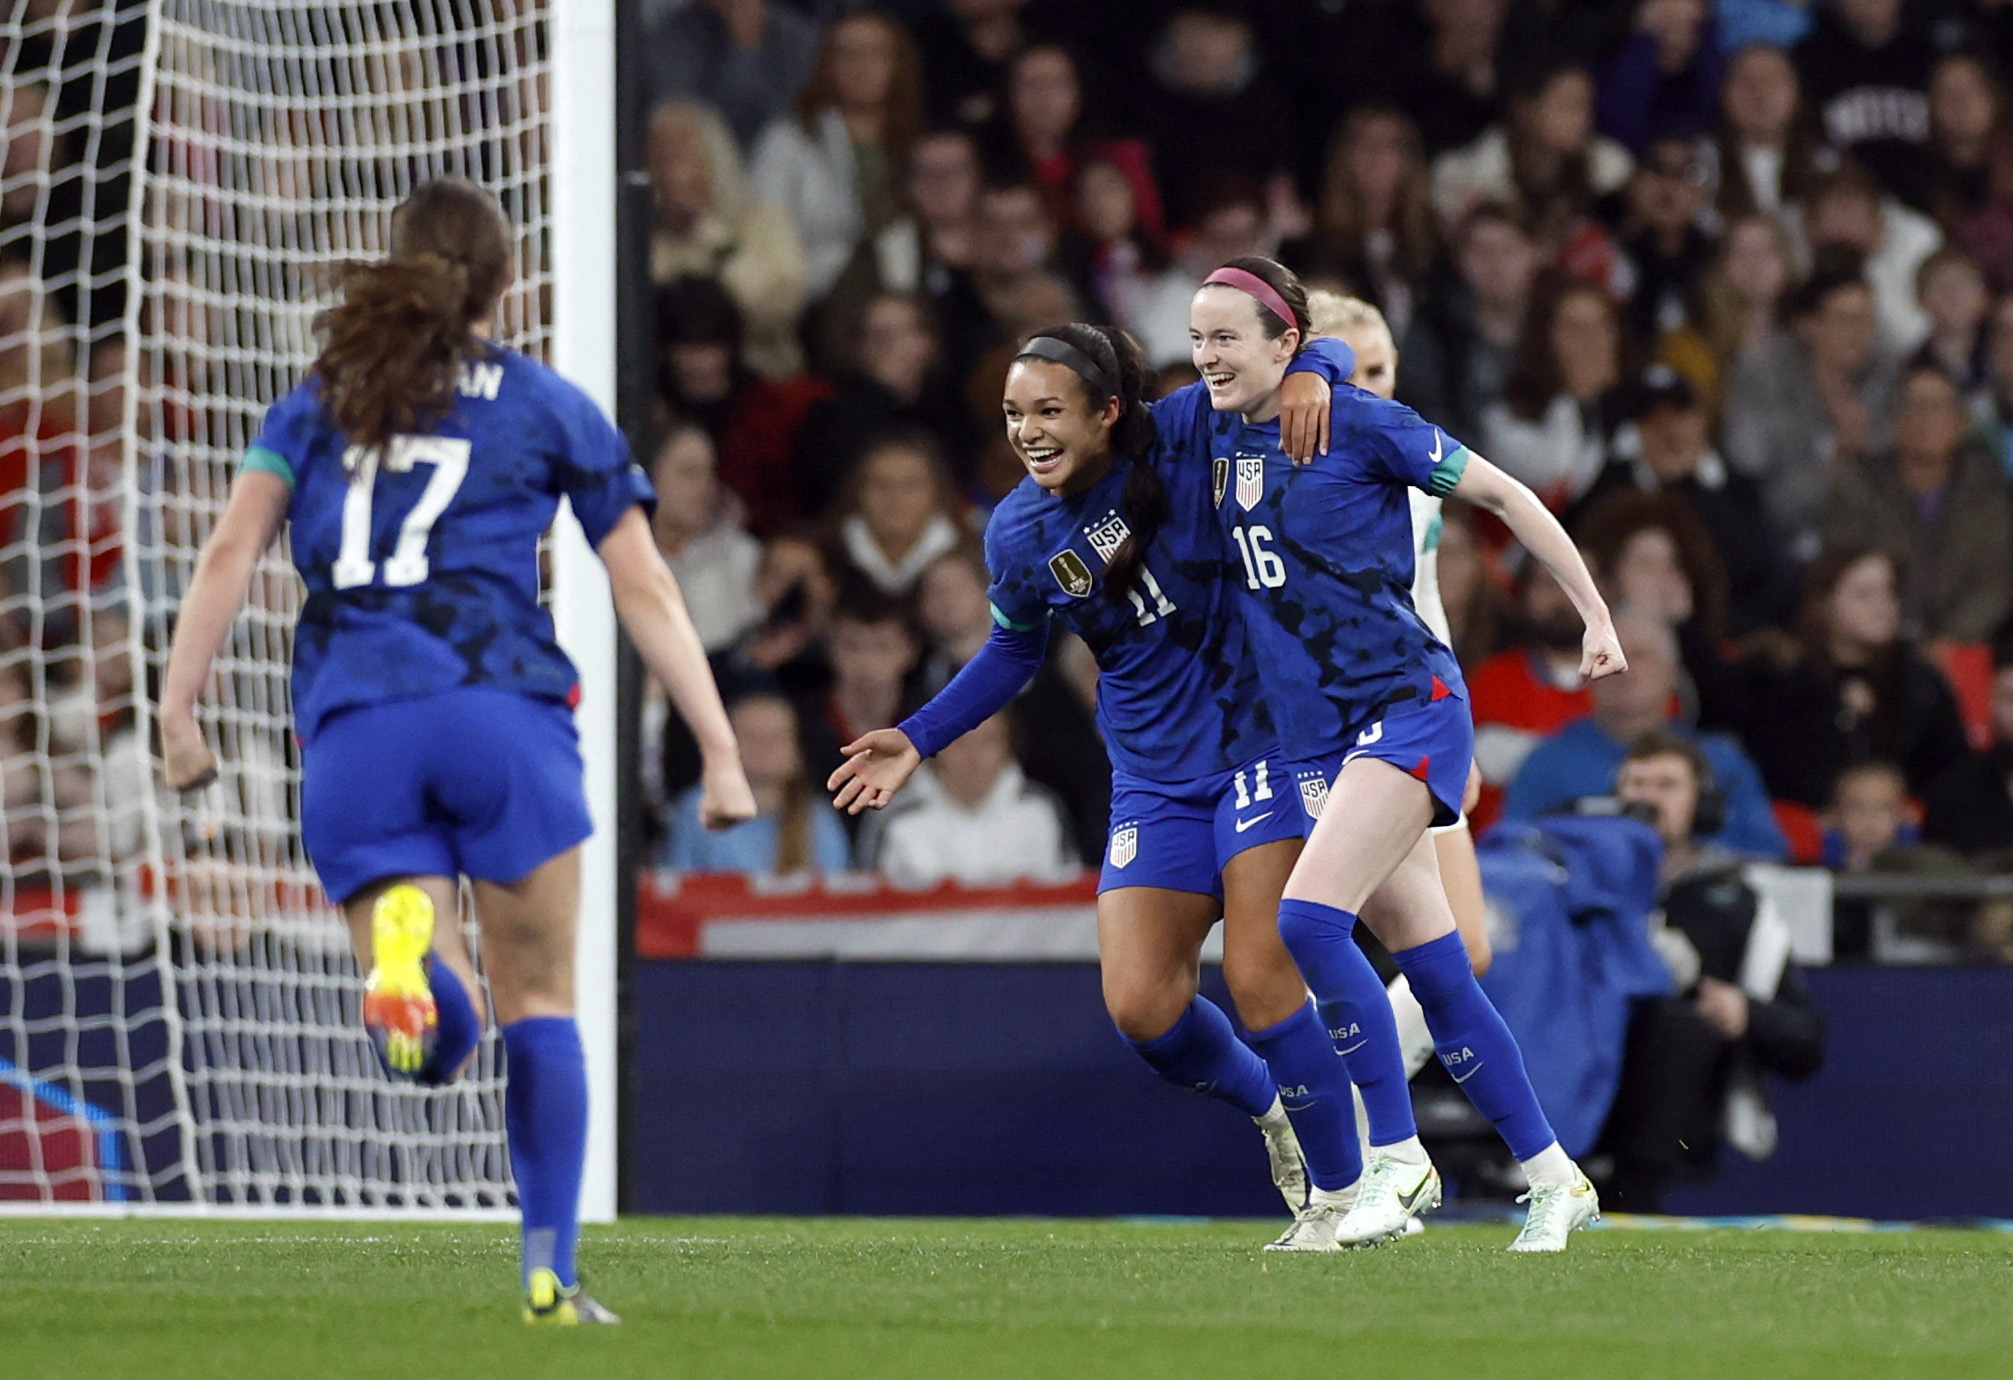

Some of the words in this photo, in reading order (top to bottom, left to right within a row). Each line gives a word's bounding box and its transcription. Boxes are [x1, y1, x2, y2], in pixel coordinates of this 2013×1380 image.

[1238, 462, 1261, 482] USA
[331, 433, 472, 590] 17
[1091, 520, 1125, 548] USA
[1232, 525, 1286, 590] 16
[1234, 760, 1273, 810] 11
[1302, 781, 1326, 798] USA
[1113, 830, 1135, 847] USA
[1329, 1022, 1361, 1040] USA
[1442, 1046, 1475, 1066] USA
[1278, 1084, 1309, 1098] USA
